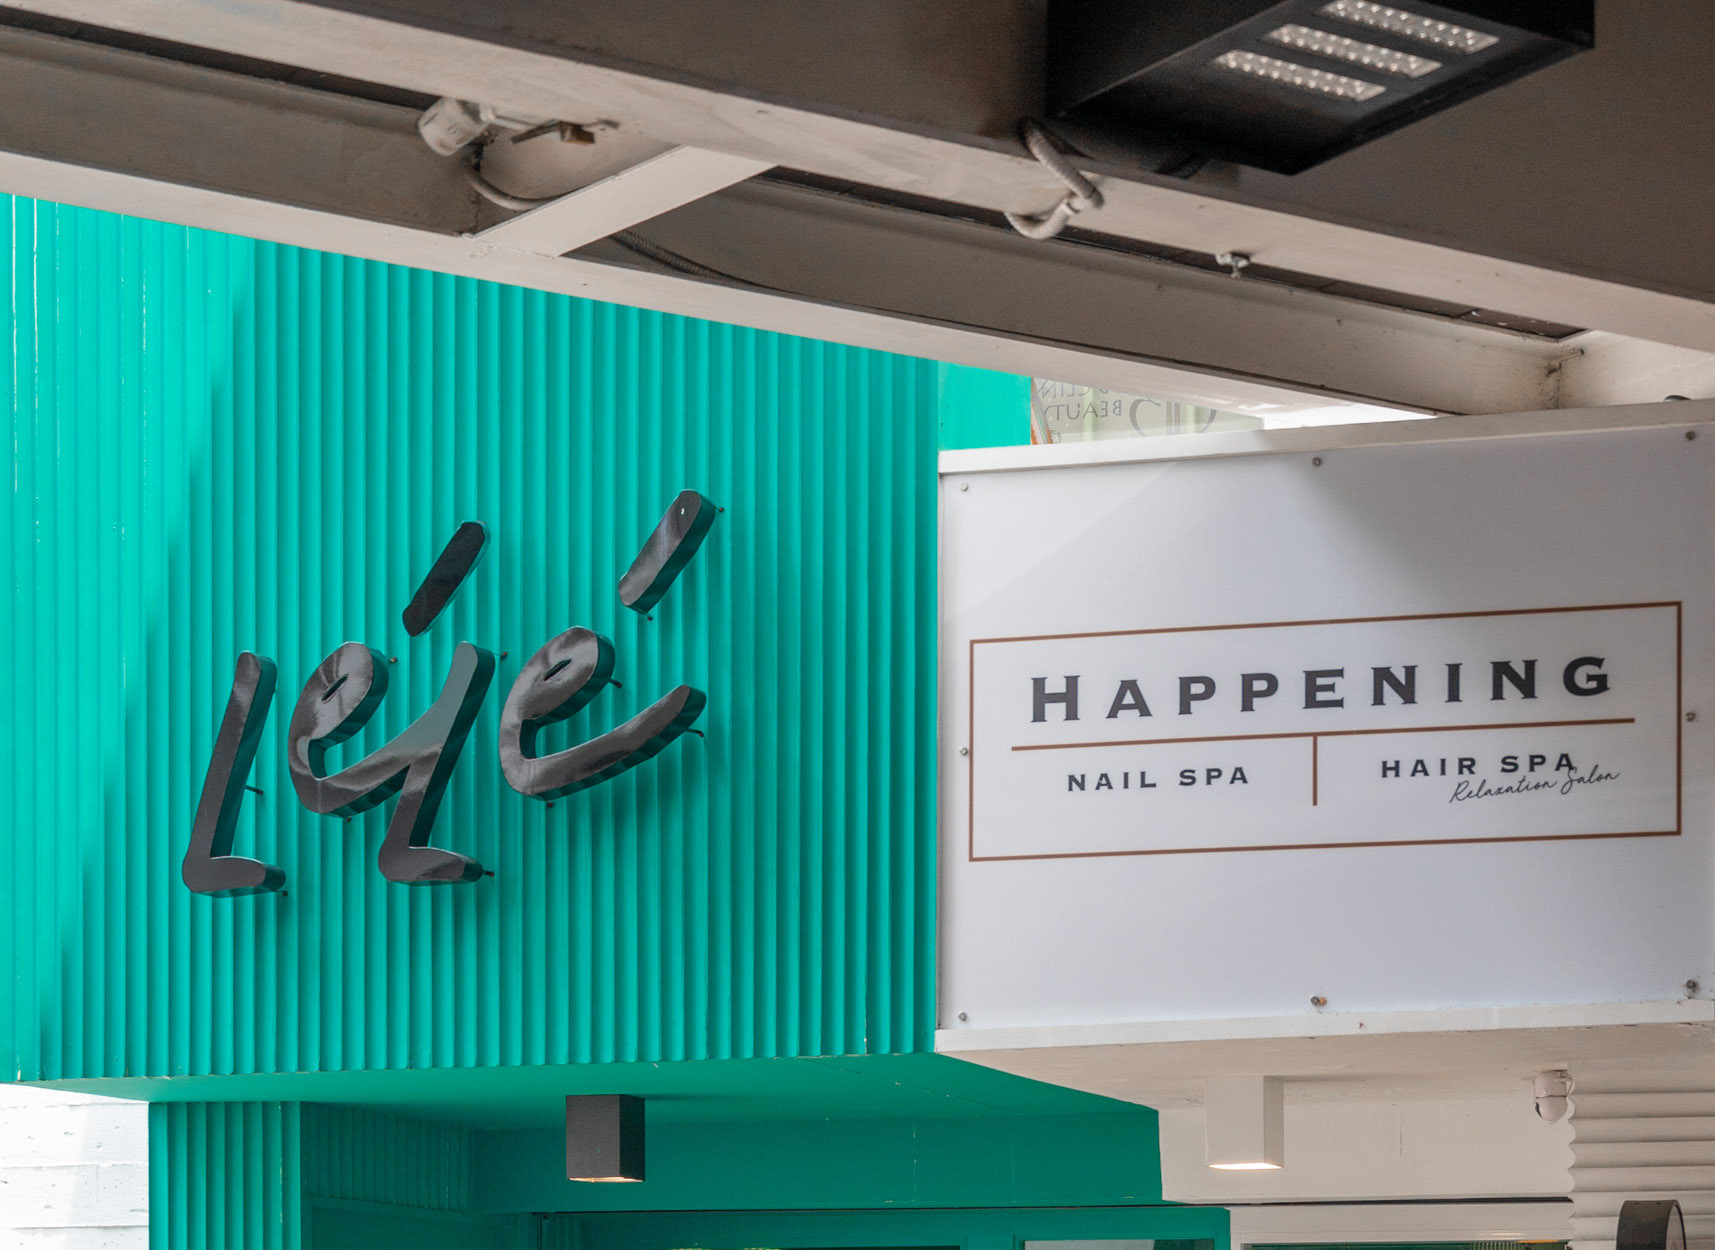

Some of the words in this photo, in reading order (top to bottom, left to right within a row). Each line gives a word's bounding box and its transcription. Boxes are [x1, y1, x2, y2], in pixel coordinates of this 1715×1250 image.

[1030, 656, 1611, 723] HAPPENING
[1066, 770, 1157, 792] NAIL
[1178, 765, 1249, 787] SPA
[1380, 757, 1476, 778] HAIR
[1500, 752, 1574, 774] SPA
[1449, 775, 1558, 804] Relaxation
[1560, 763, 1621, 795] Salon
